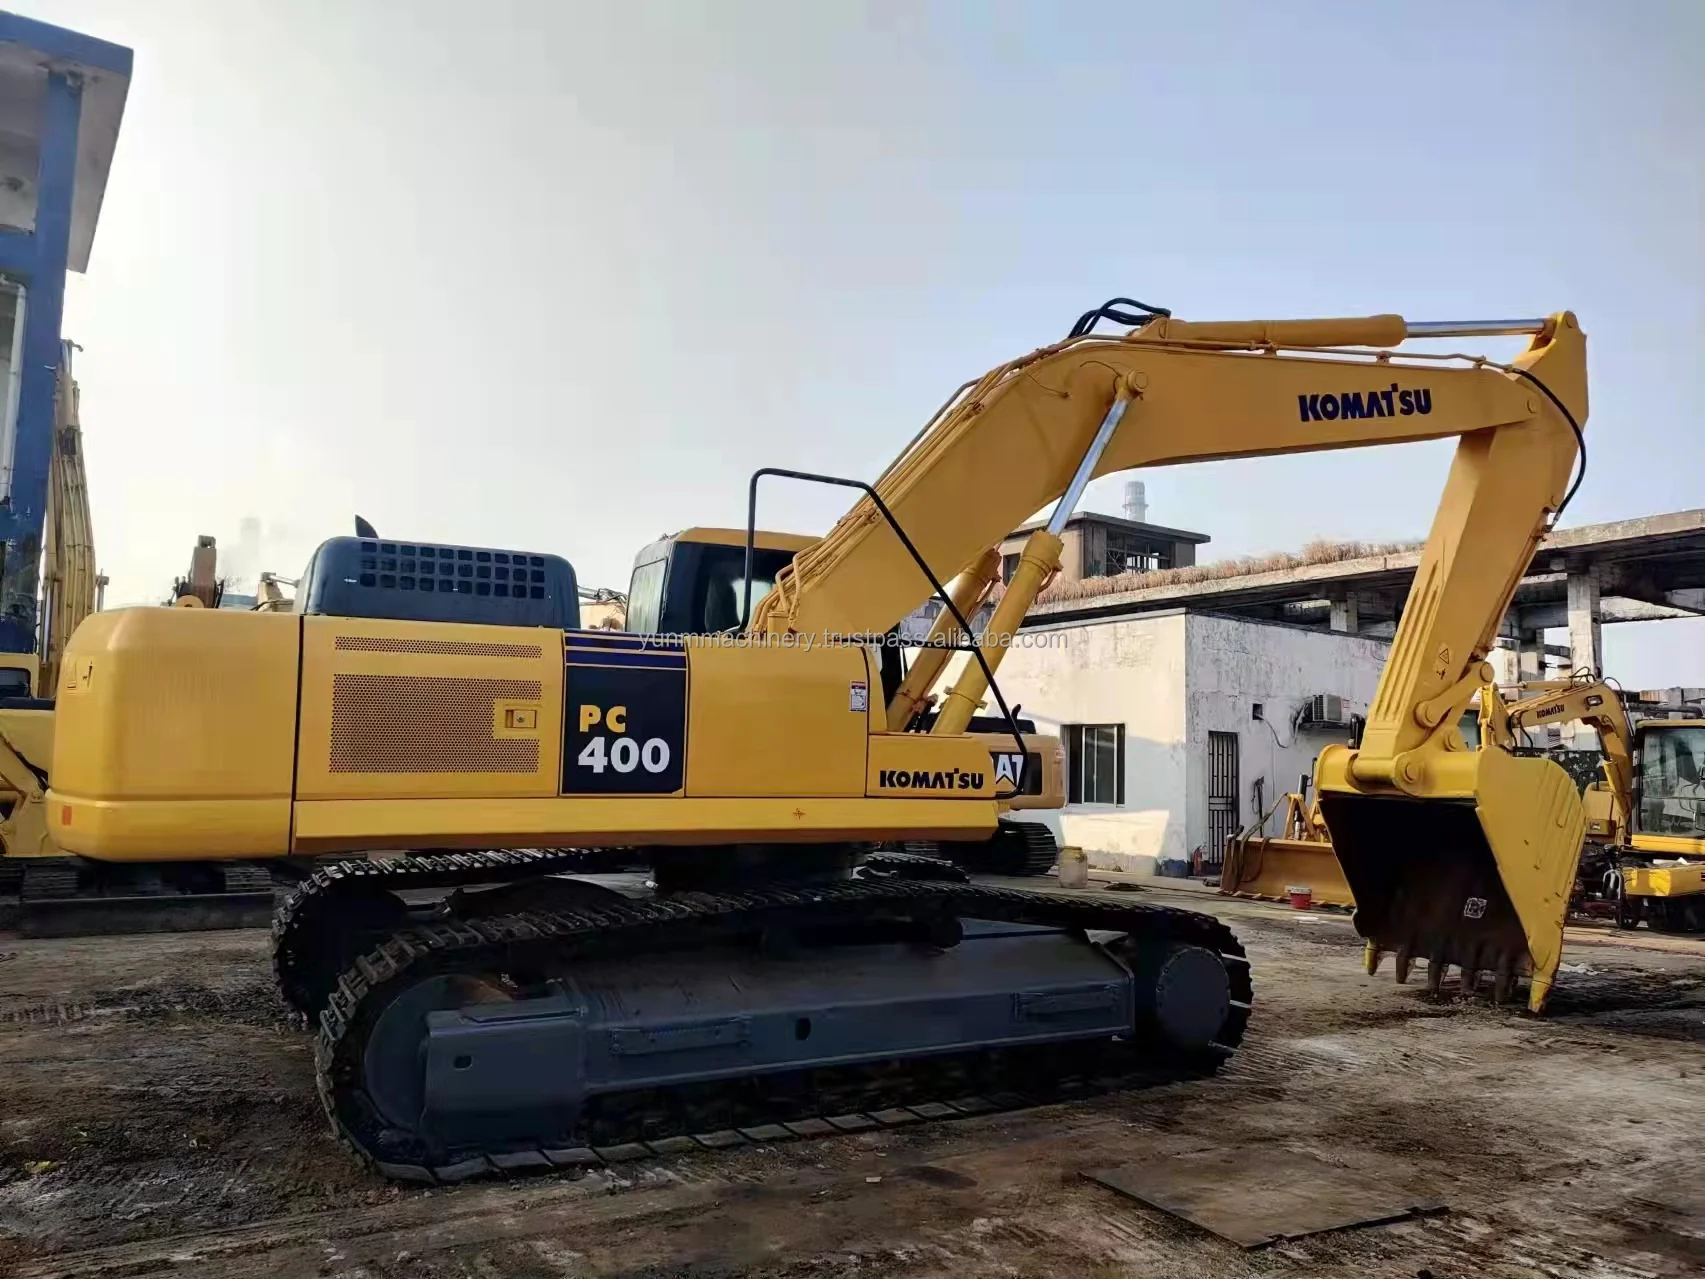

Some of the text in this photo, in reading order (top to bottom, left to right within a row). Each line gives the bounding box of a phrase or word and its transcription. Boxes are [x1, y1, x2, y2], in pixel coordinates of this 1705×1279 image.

[1298, 383, 1432, 422] KOMATSU
[579, 704, 627, 733] PC
[1536, 704, 1565, 719] KOMATSU
[577, 736, 670, 774] 400
[992, 754, 1024, 787] AT
[880, 768, 984, 790] KOMATSU
